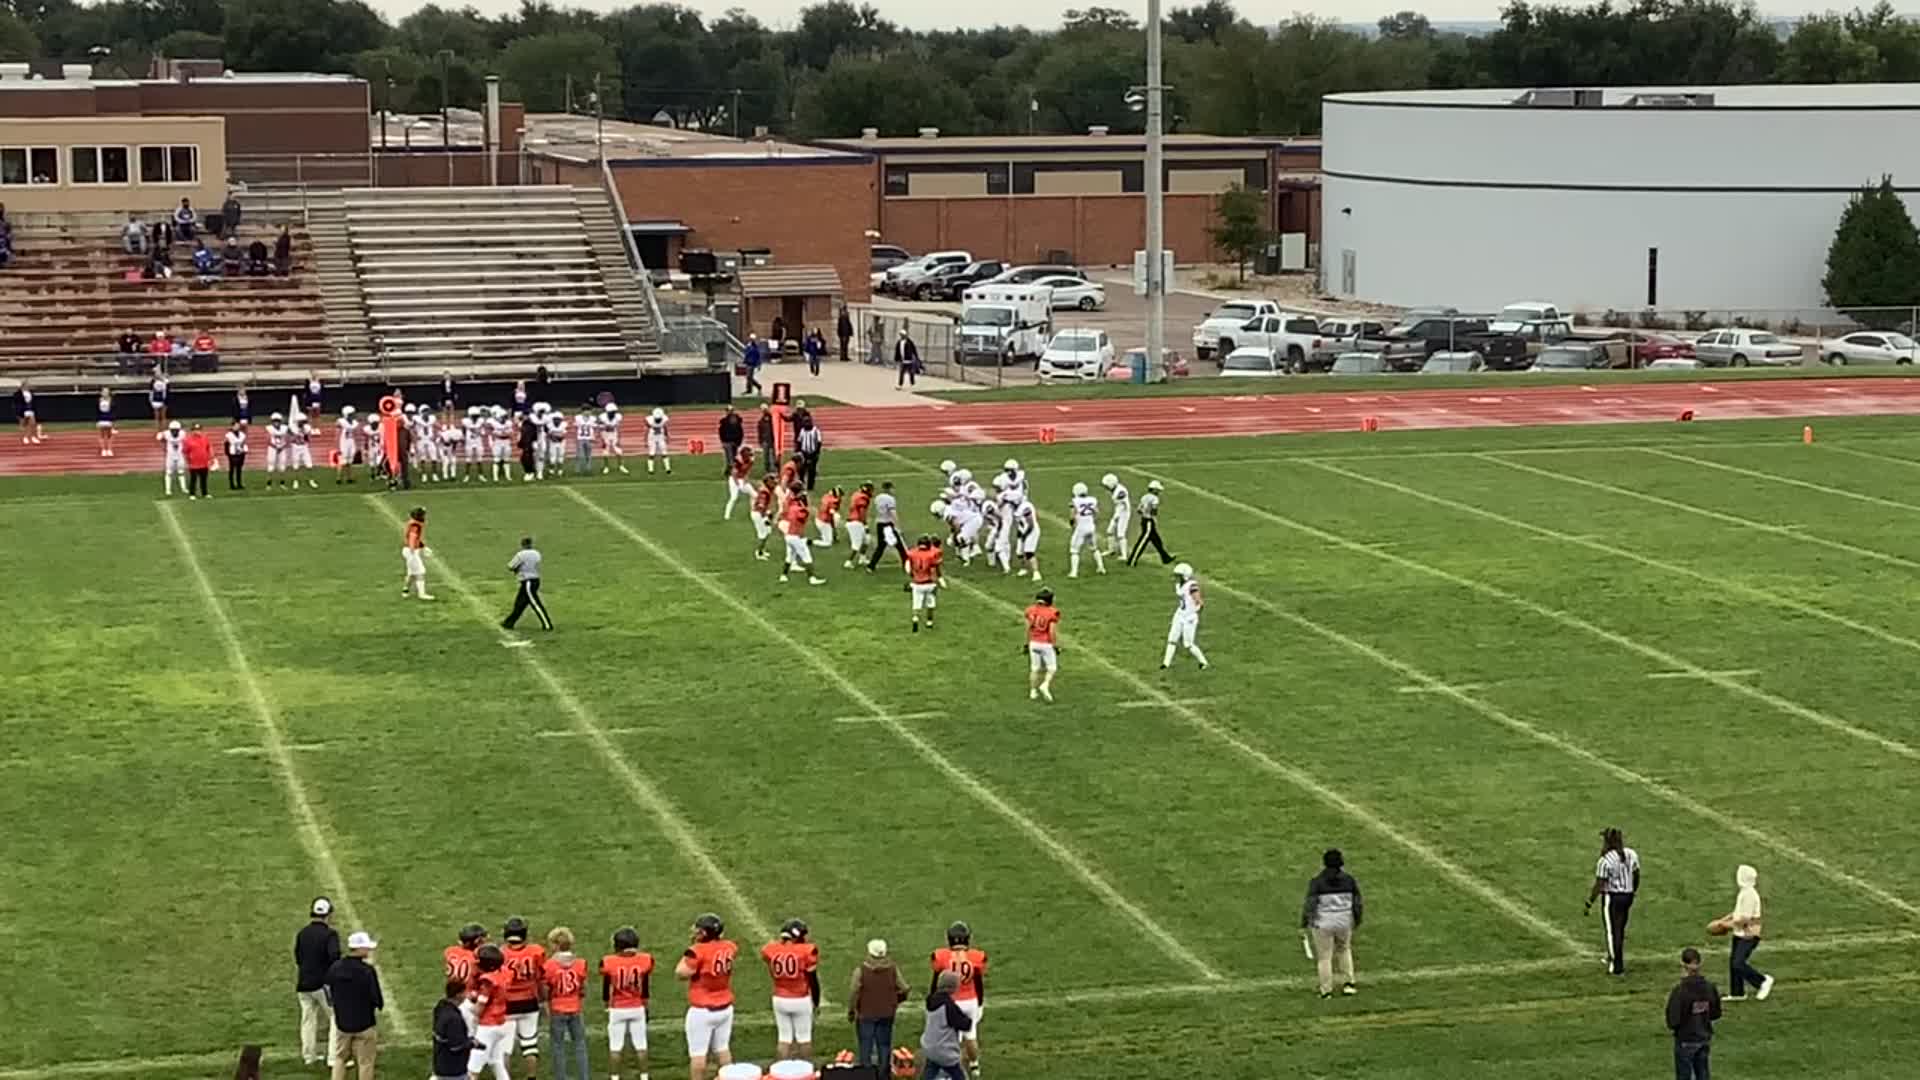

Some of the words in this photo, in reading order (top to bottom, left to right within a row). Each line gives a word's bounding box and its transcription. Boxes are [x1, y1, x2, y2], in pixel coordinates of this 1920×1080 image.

[776, 385, 787, 402] 1
[689, 440, 704, 454] 30
[1079, 503, 1097, 516] 25
[772, 953, 796, 976] 60
[558, 970, 577, 995] 13
[619, 967, 640, 990] 14
